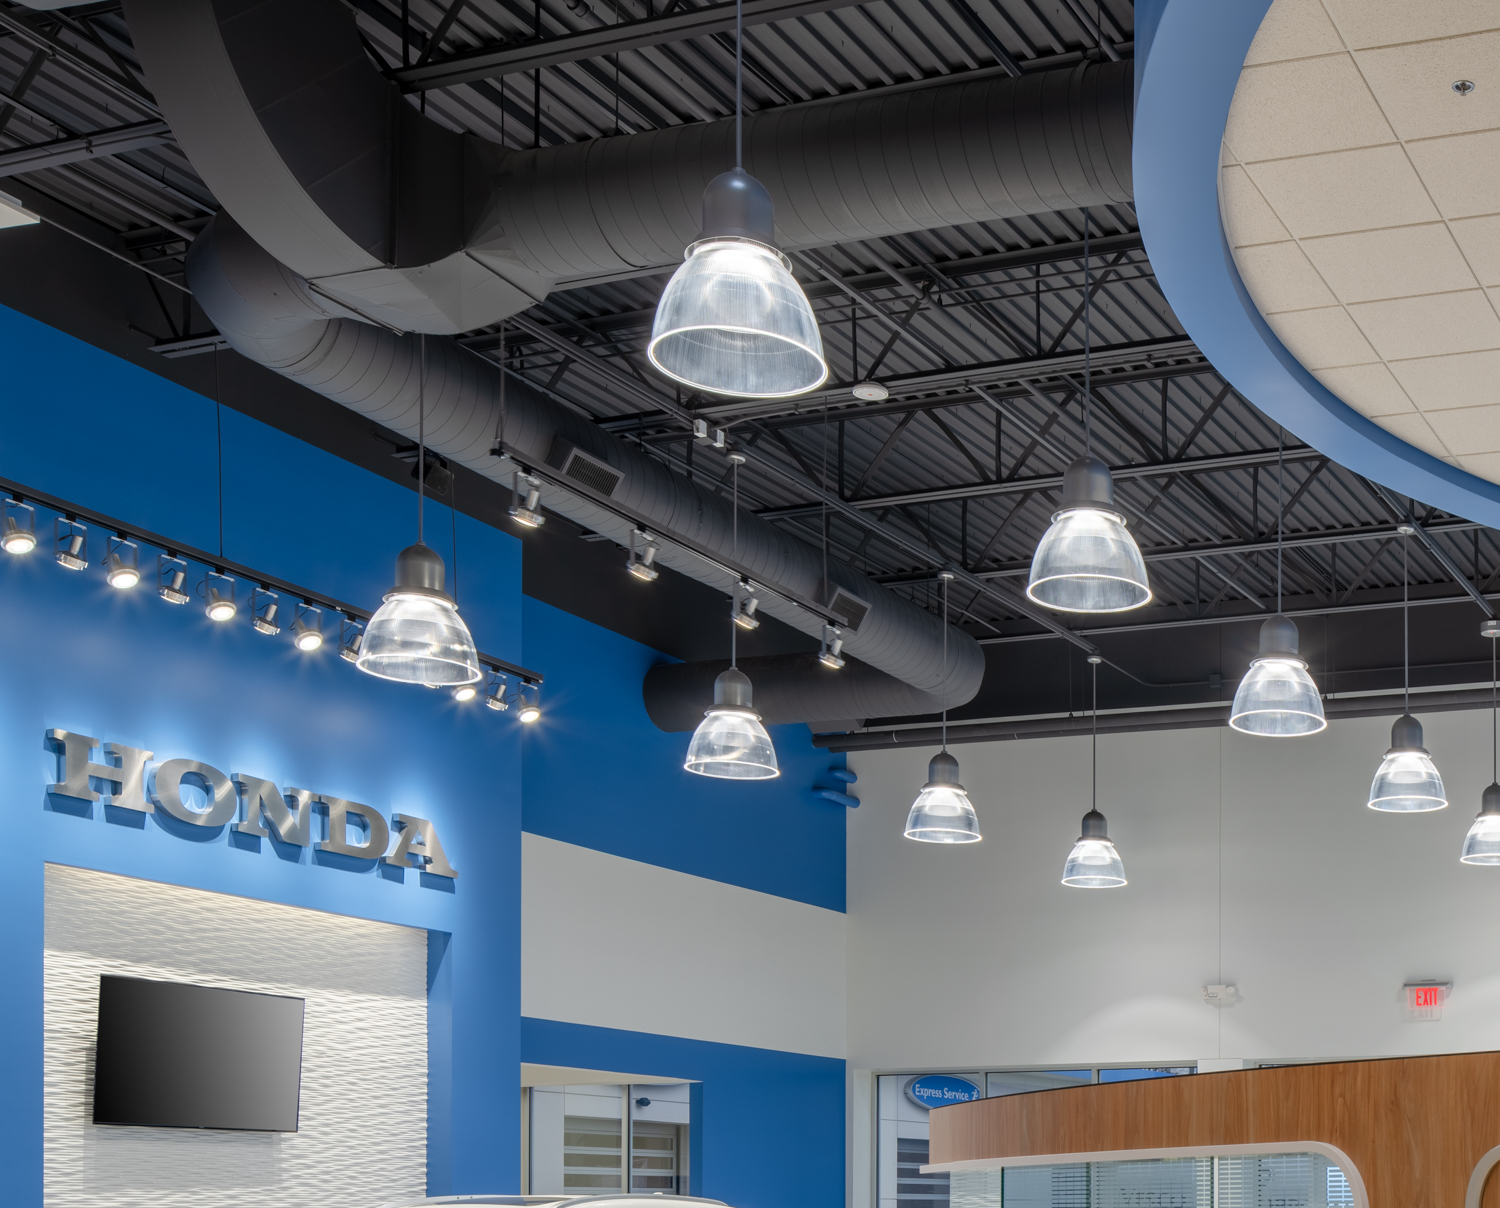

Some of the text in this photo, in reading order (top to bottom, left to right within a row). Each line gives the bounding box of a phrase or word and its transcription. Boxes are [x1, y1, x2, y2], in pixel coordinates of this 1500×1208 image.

[43, 728, 459, 879] HONDA
[1415, 987, 1439, 1006] EXIT
[915, 1084, 969, 1101] Express Service
